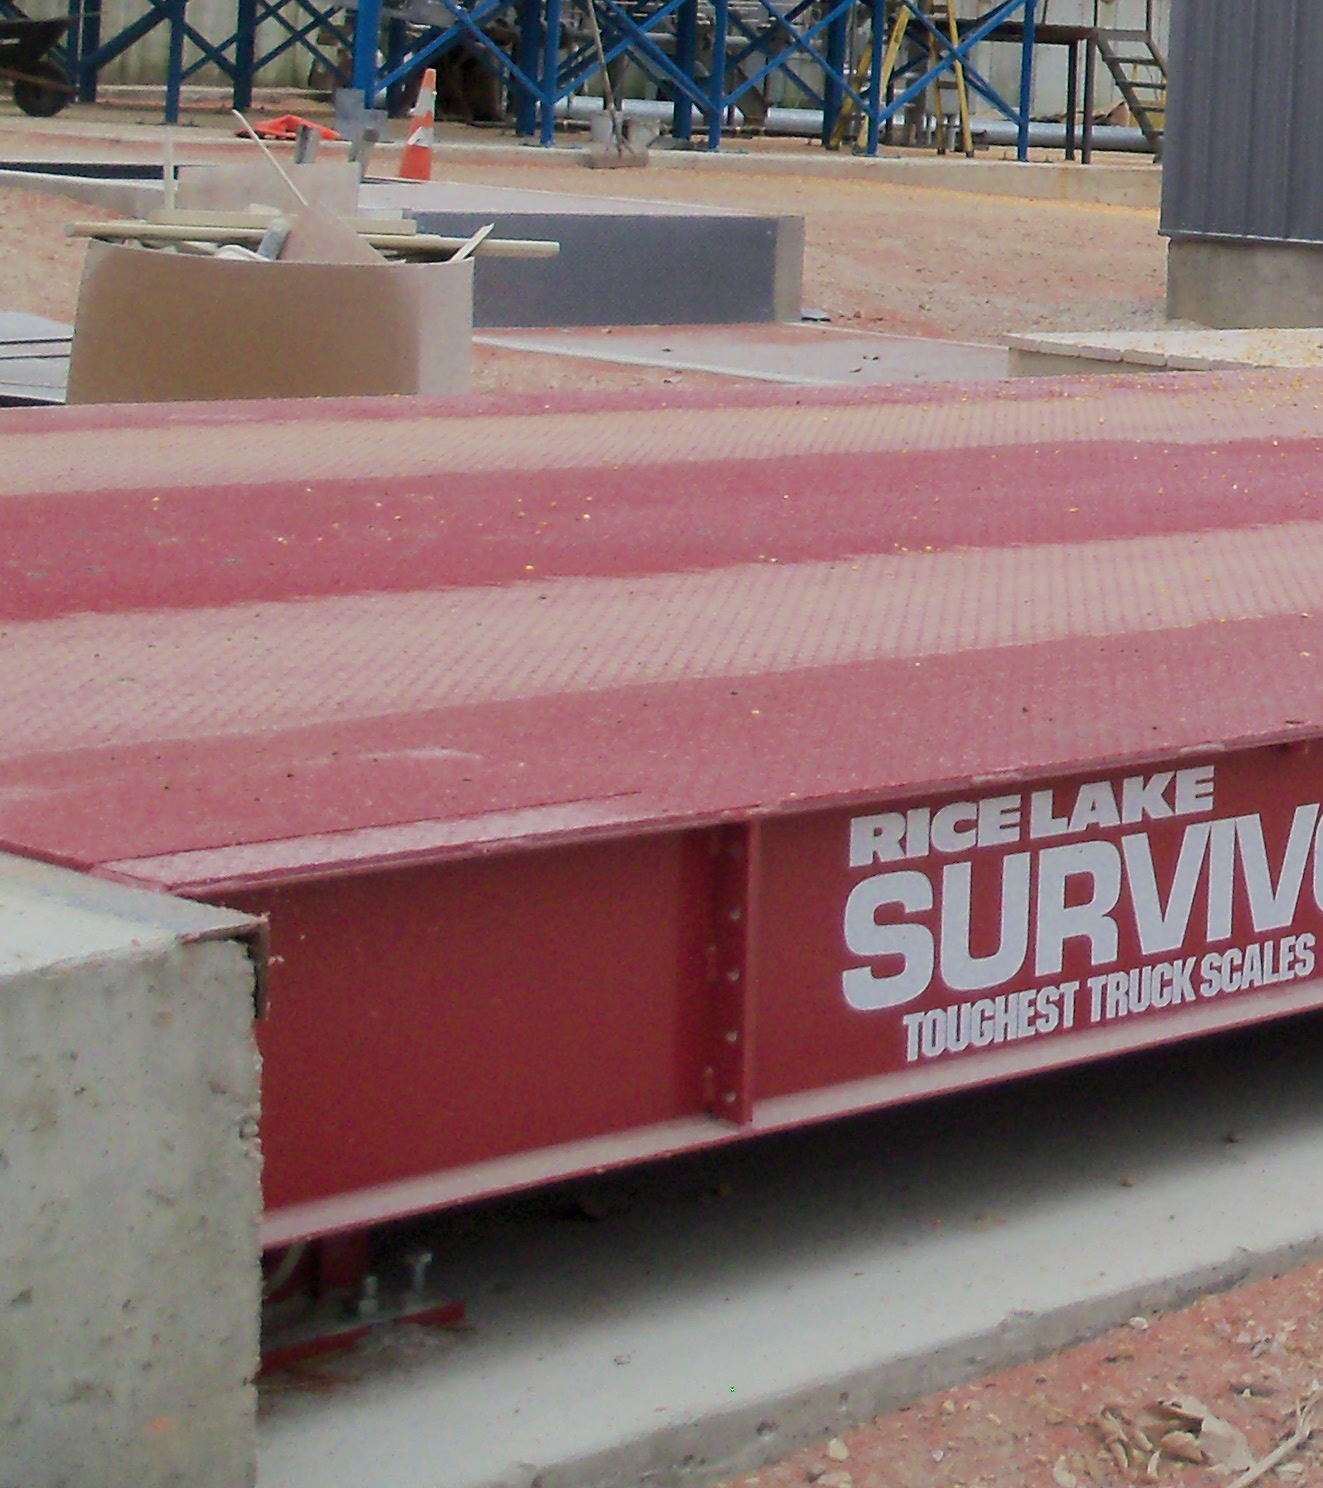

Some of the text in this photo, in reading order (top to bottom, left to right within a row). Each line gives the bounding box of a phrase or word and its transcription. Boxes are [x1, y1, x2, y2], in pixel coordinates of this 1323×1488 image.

[848, 764, 1215, 869] RICE LAKE
[902, 979, 1080, 1063] TOUGHEST
[1088, 959, 1195, 1025] TRUCK
[1199, 932, 1316, 999] SCALES
